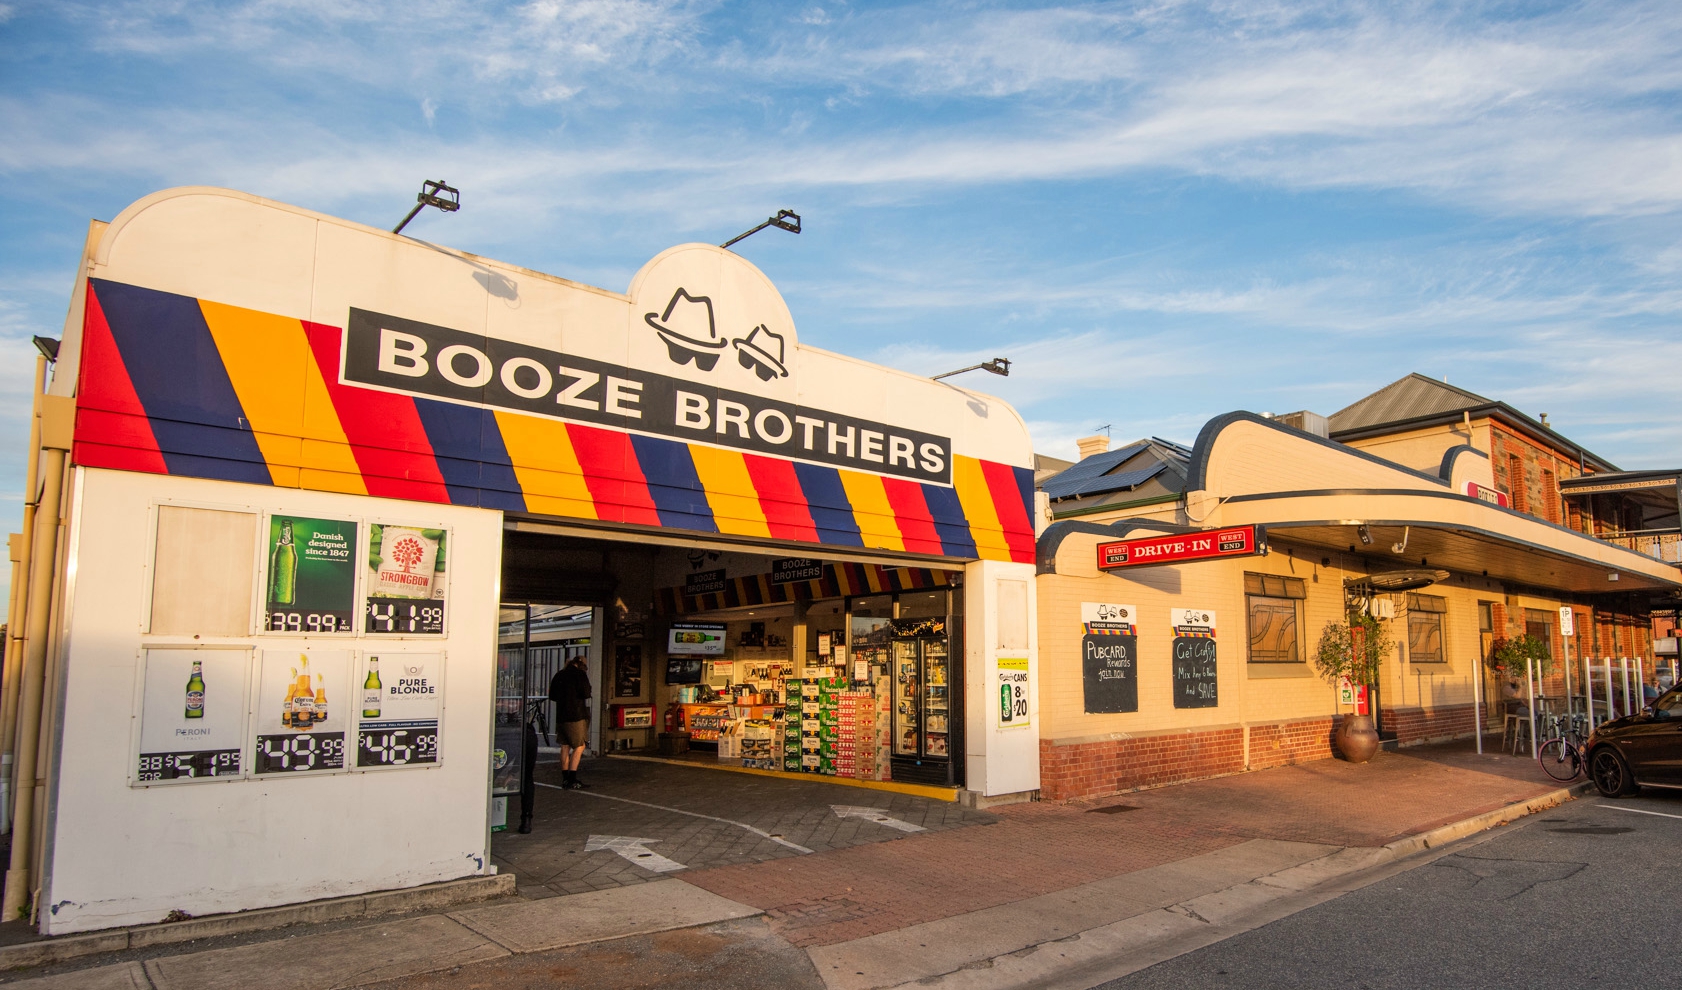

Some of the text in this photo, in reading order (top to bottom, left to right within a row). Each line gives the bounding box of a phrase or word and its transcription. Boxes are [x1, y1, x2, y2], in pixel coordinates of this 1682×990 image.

[378, 328, 946, 474] BOOZE BROTHERS
[312, 532, 344, 540] Danish
[1220, 533, 1242, 541] WEST
[308, 540, 347, 549] designed
[782, 558, 811, 570] BOOZE
[380, 572, 430, 586] STRONGBOW
[694, 572, 716, 583] BOOZE
[774, 566, 820, 580] BROTHERS
[687, 581, 724, 593] BROTHERS
[1088, 641, 1126, 659] PUBCARD
[1176, 642, 1192, 659] Get
[1106, 656, 1131, 668] Rewards
[1014, 674, 1027, 682] CANS
[1098, 668, 1125, 681] join now
[1178, 667, 1190, 680] Mix
[1192, 667, 1202, 680] Any
[400, 678, 427, 686] PURE
[1015, 686, 1021, 698] 8
[1186, 682, 1216, 698] And SAVE
[1013, 699, 1027, 716] $20
[176, 728, 211, 736] PERONI
